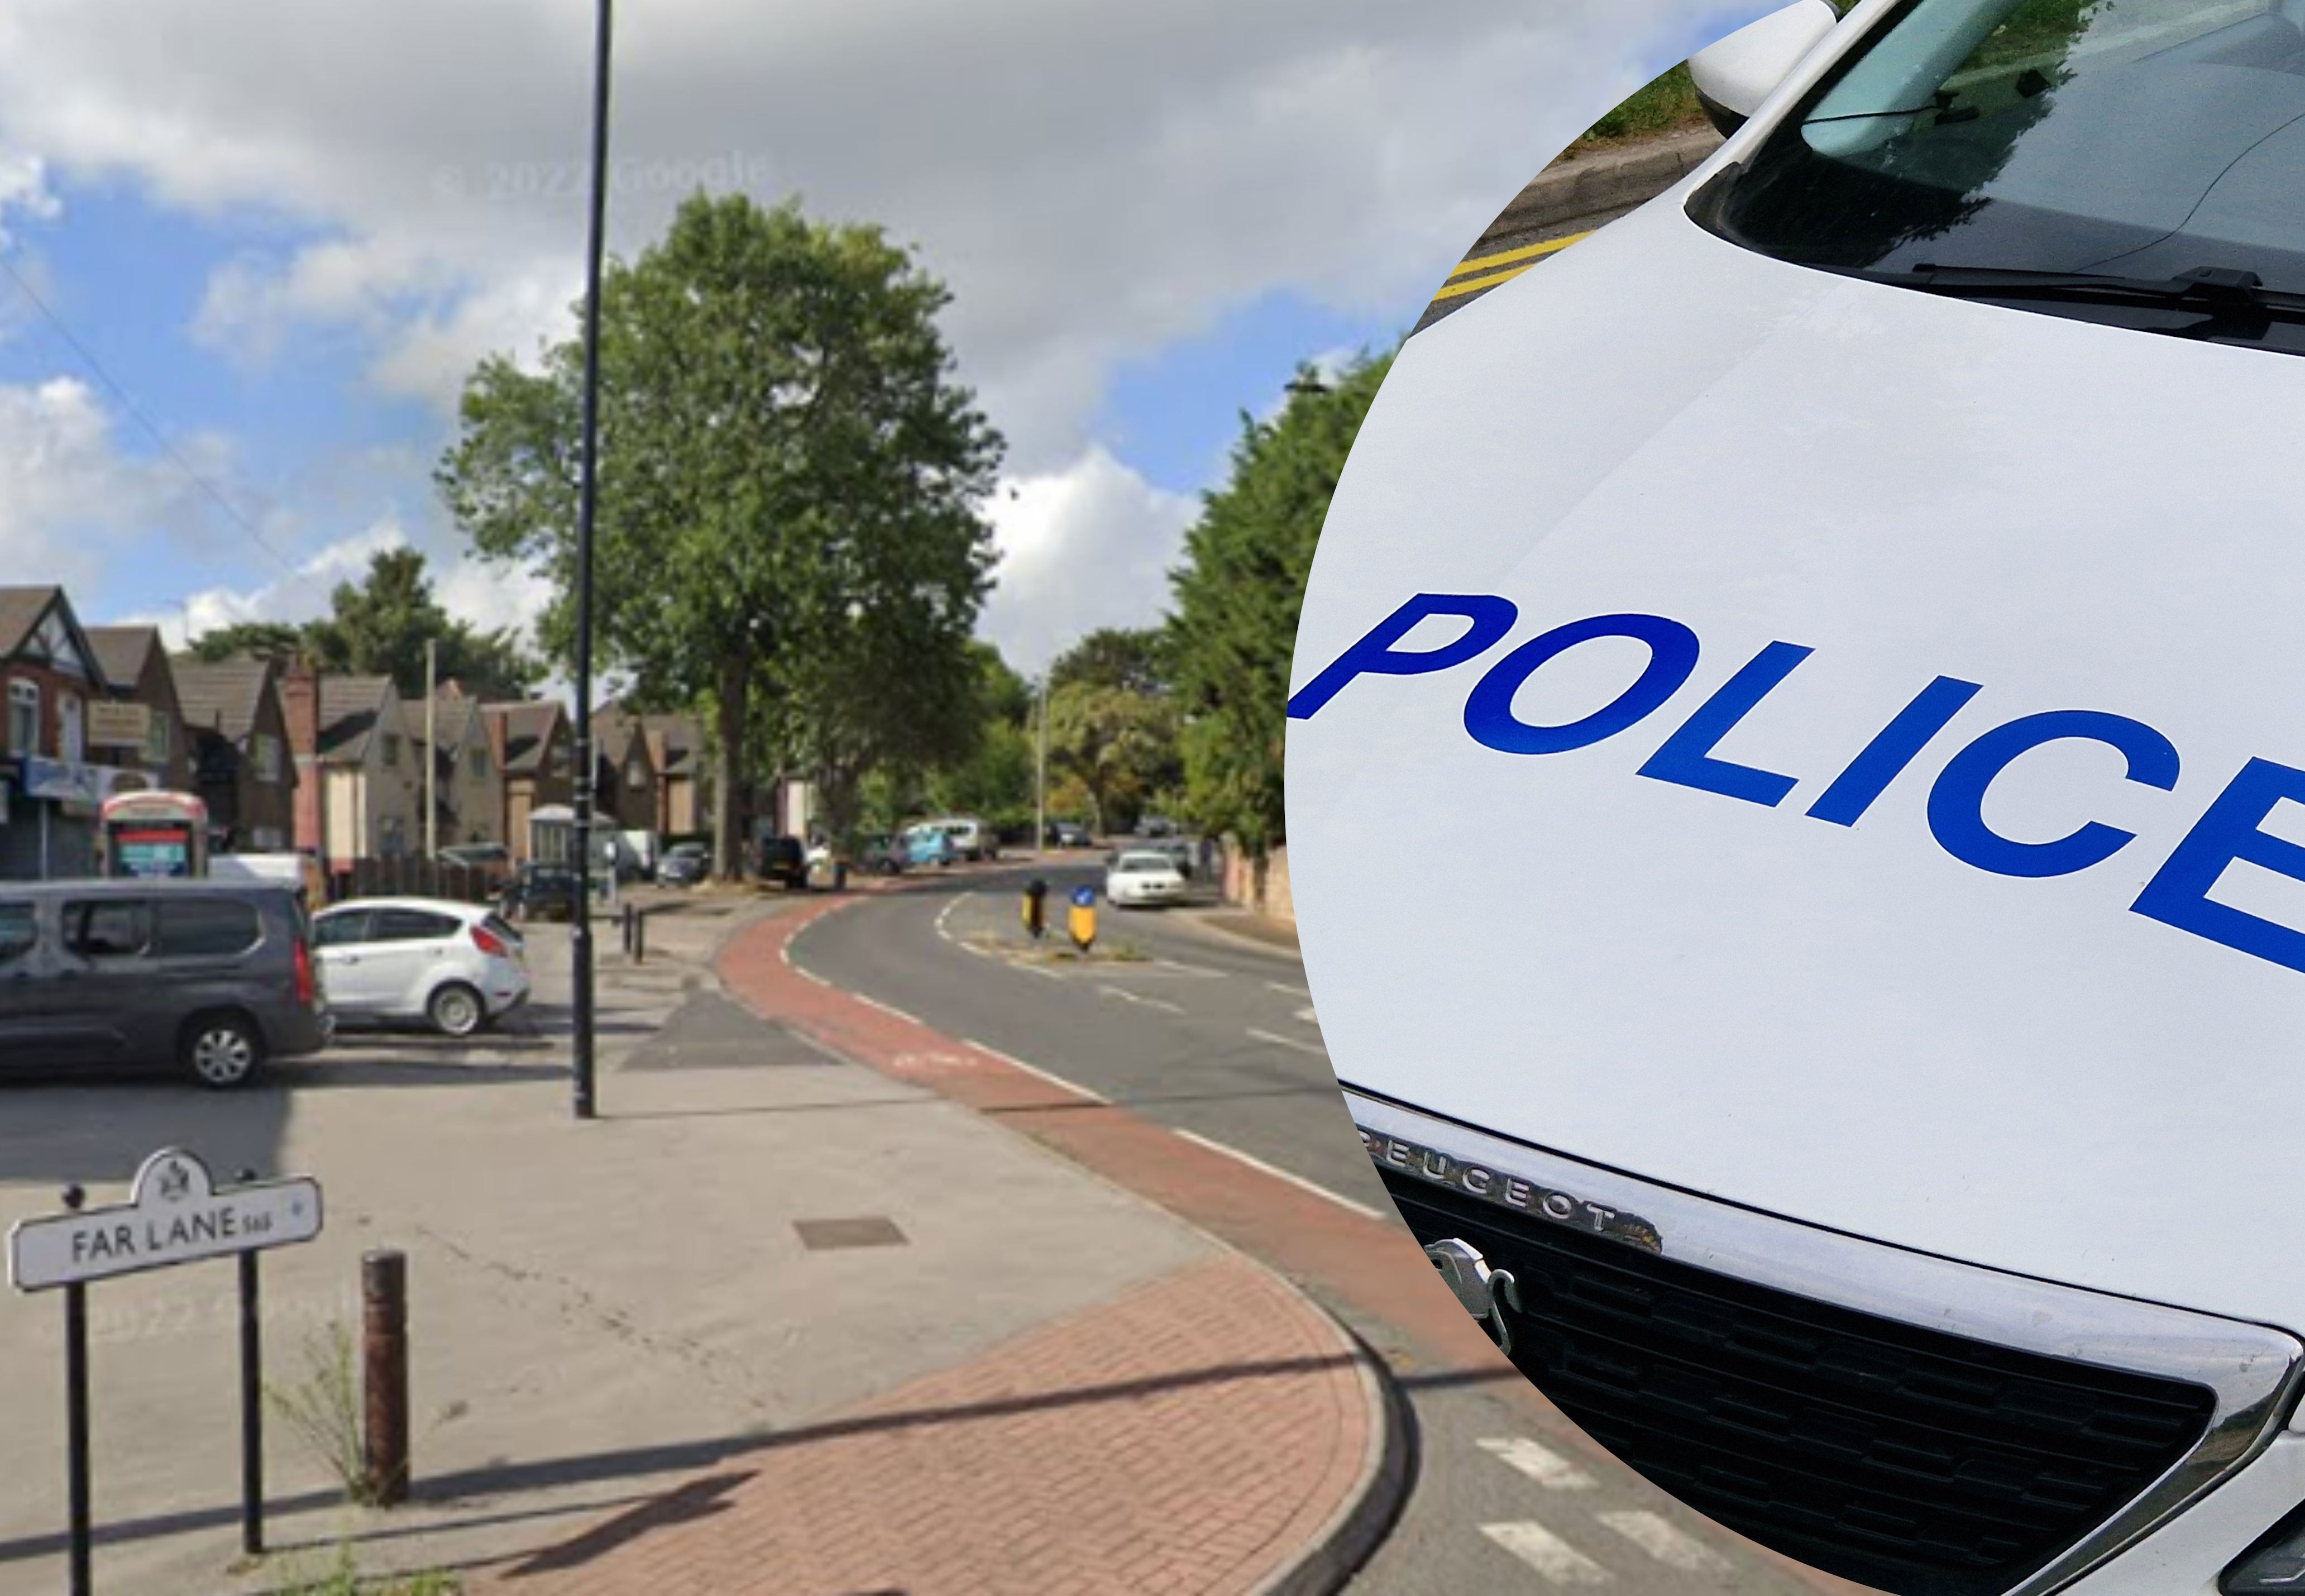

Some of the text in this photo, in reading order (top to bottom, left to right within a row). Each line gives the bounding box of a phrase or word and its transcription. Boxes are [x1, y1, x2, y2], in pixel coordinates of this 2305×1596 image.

[1287, 592, 2305, 973] POLICE
[73, 1225, 135, 1263] FAR
[146, 1206, 238, 1250] LANE
